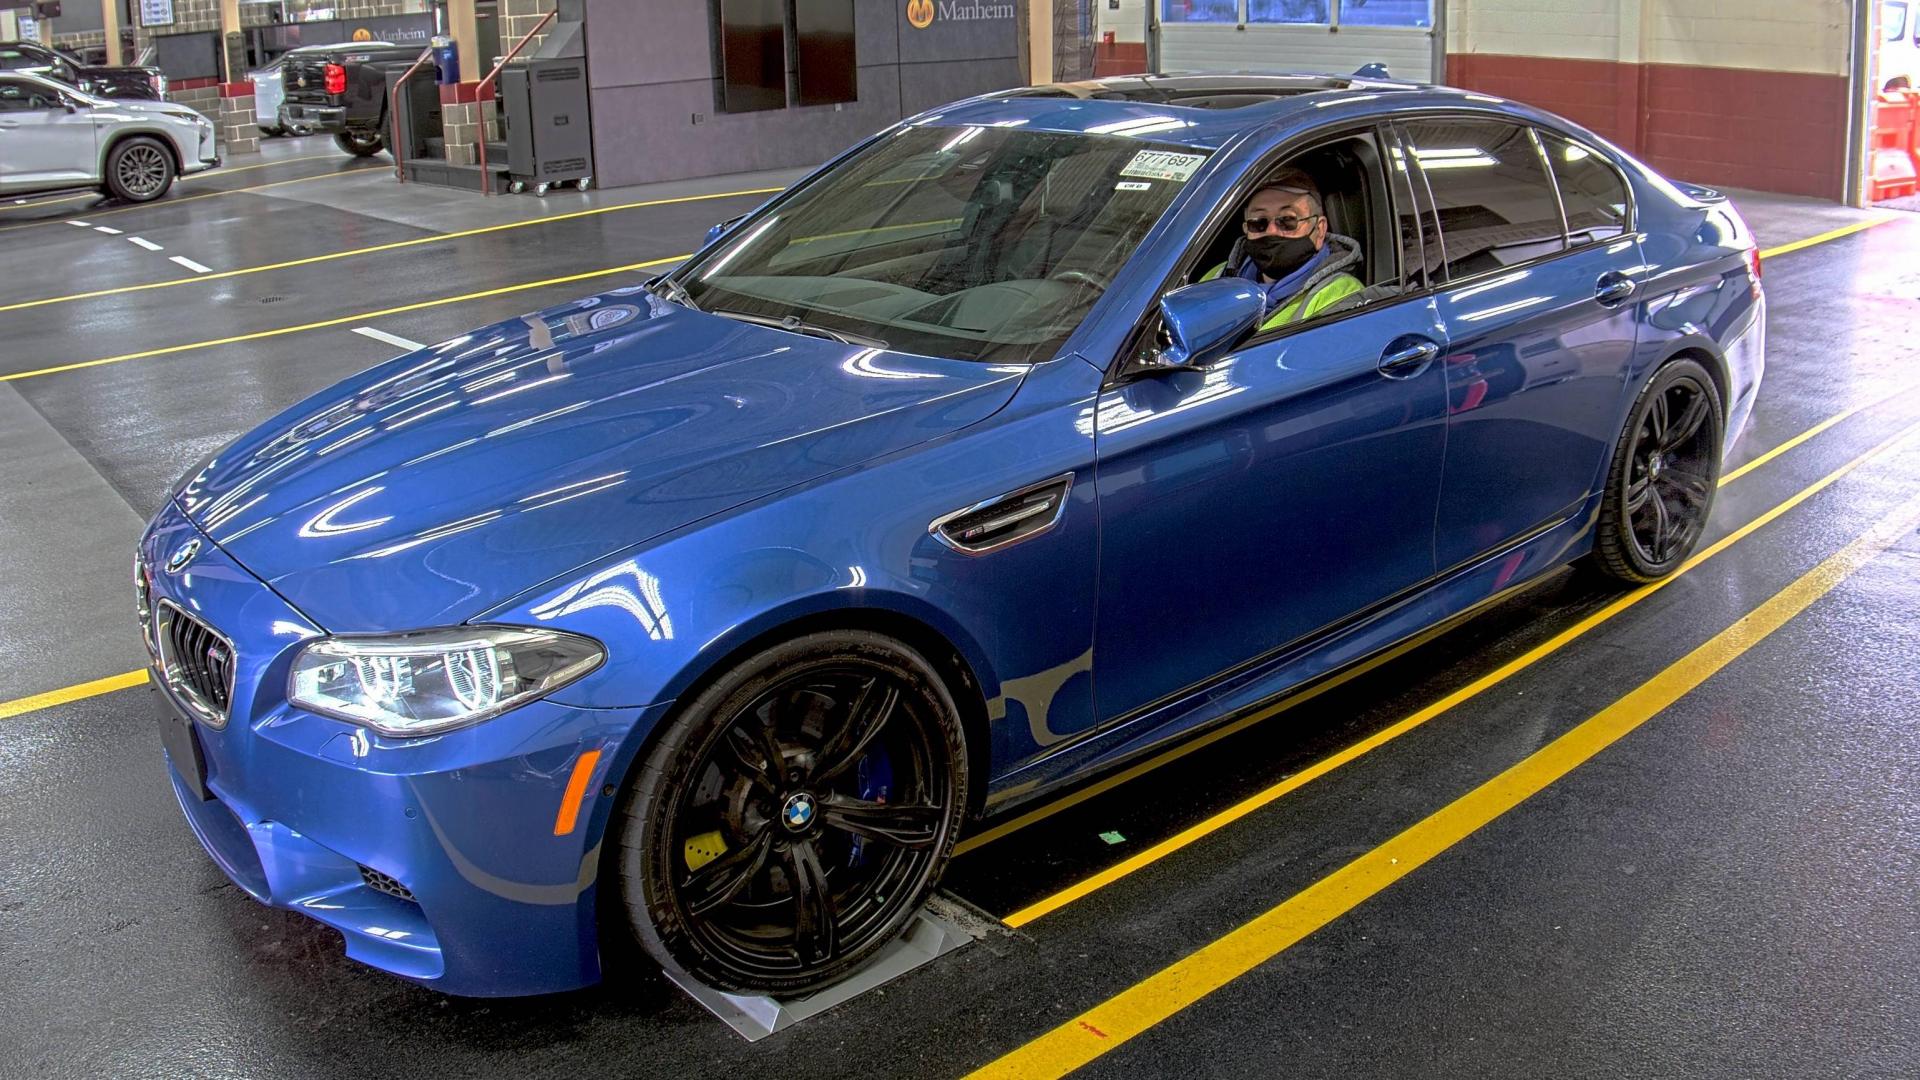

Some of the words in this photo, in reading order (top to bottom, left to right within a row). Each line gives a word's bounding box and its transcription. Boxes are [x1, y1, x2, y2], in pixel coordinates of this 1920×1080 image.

[937, 0, 1015, 21] Manheim
[373, 28, 426, 42] Manheim
[1134, 152, 1198, 168] 6777697
